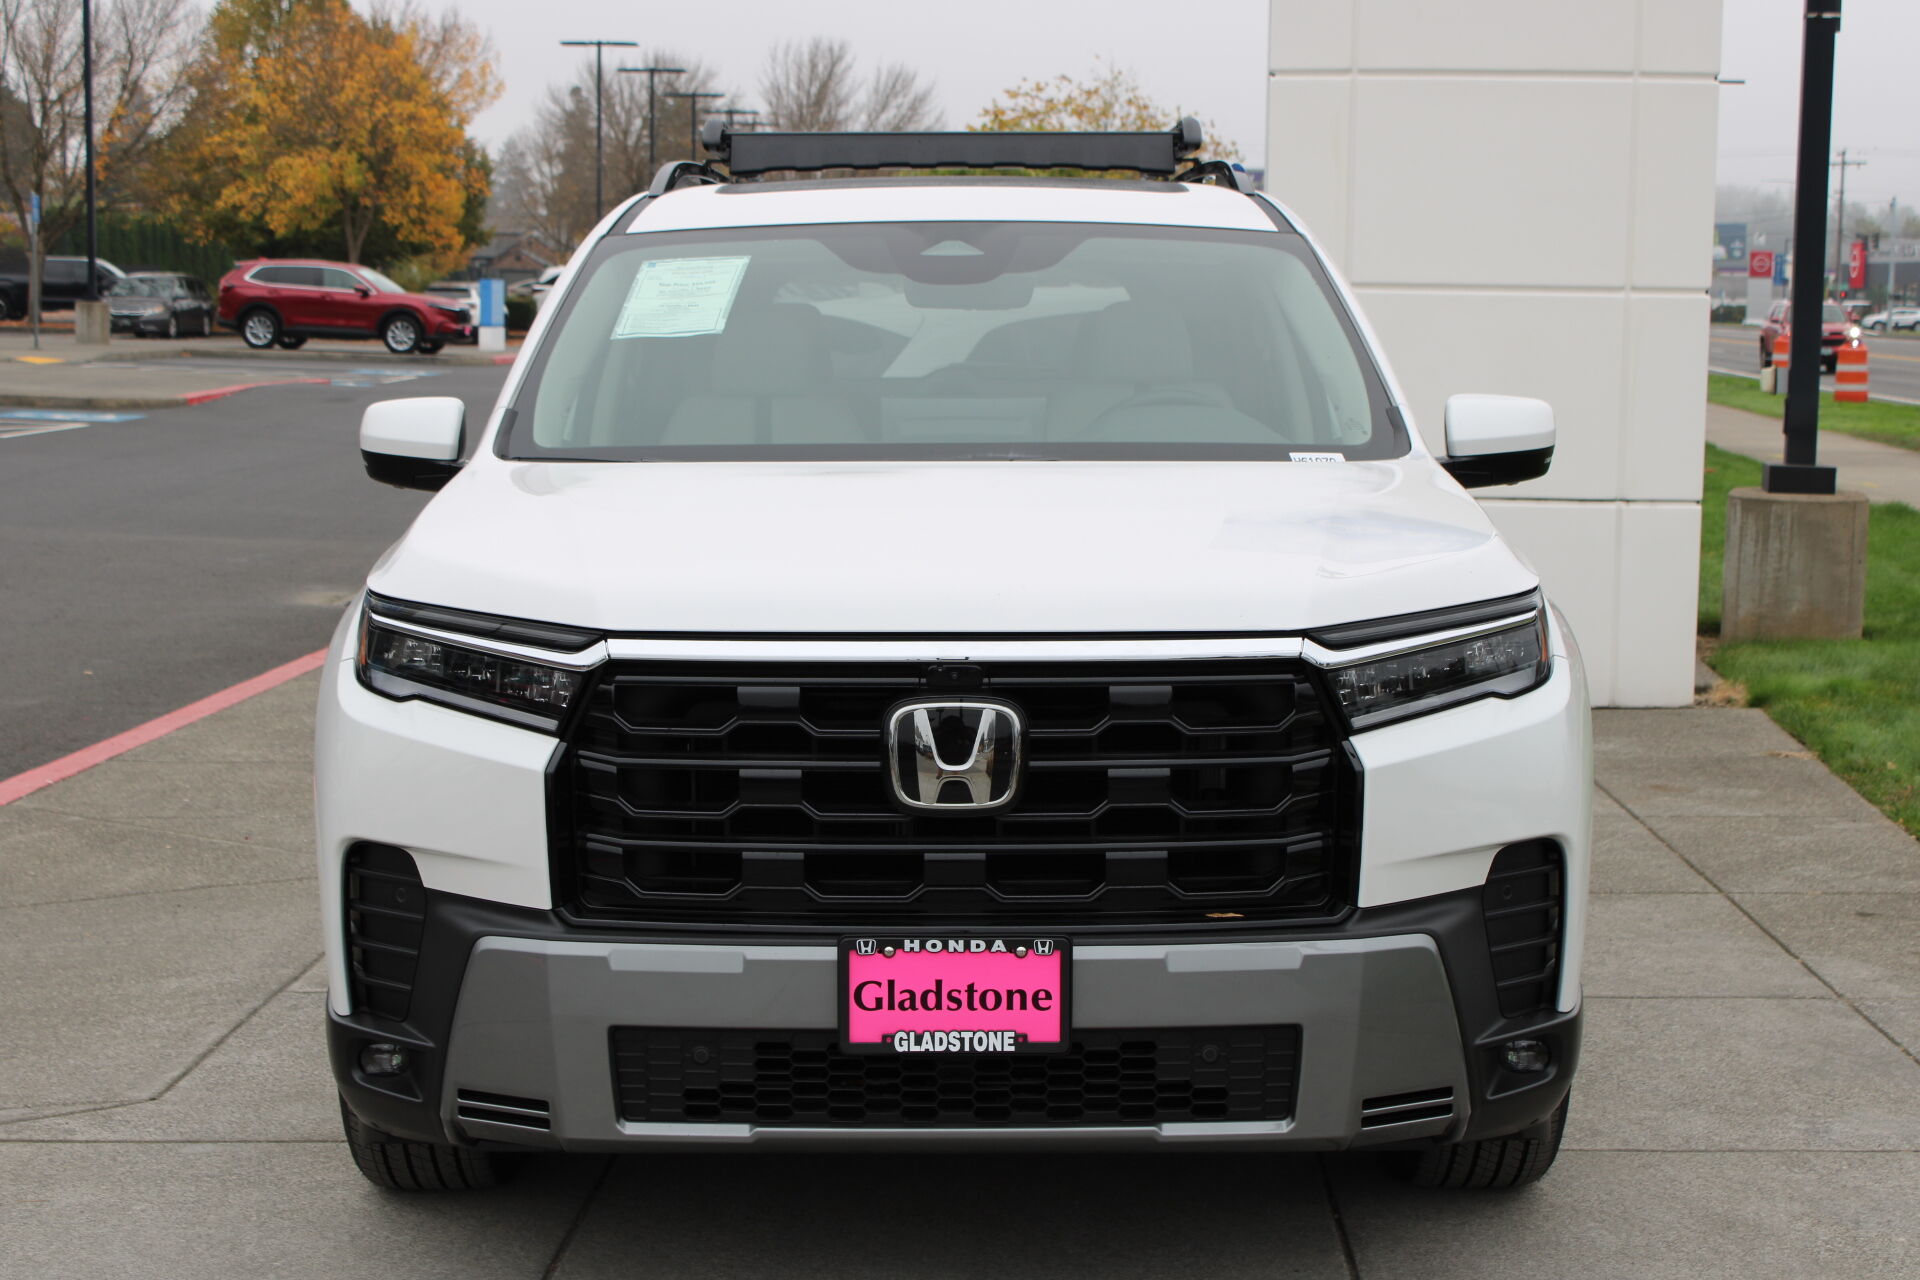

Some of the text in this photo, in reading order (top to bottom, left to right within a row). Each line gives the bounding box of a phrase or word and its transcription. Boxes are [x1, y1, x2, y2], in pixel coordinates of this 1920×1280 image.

[904, 939, 1008, 953] HONDA
[852, 979, 1053, 1012] Gladstone
[893, 1030, 1016, 1052] GLADSTONE
